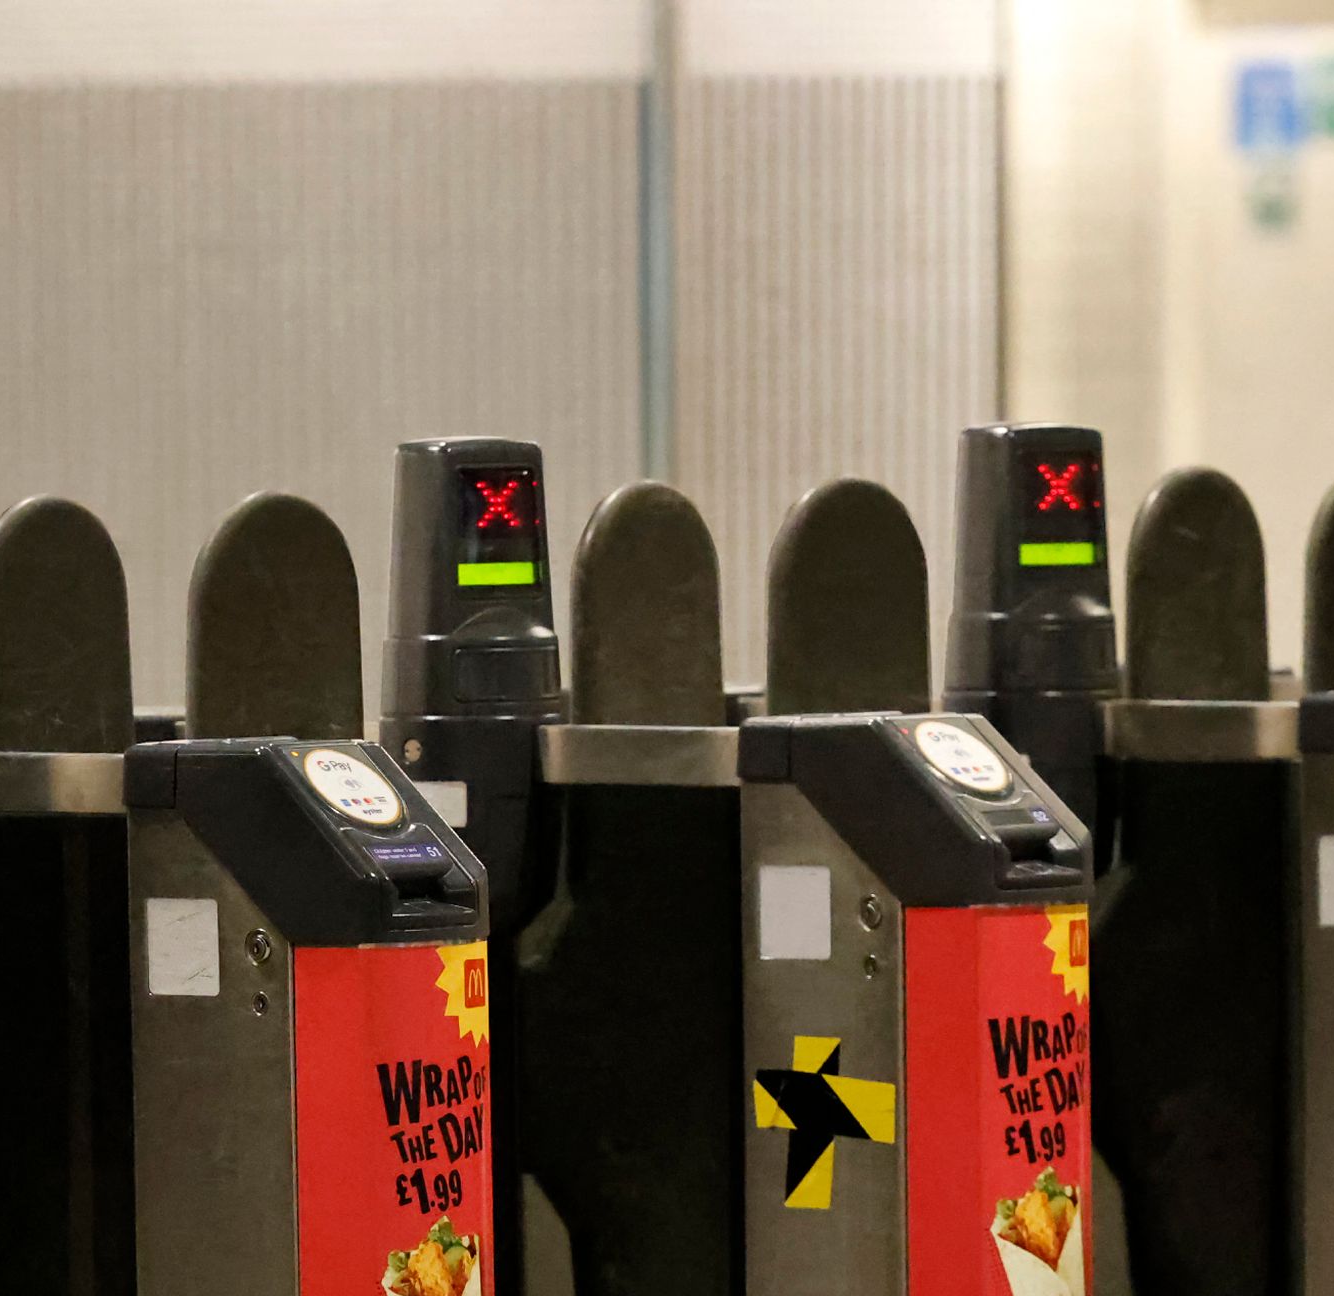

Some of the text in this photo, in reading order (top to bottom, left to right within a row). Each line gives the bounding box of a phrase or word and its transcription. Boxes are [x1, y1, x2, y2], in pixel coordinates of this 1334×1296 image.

[425, 846, 443, 857] 51
[988, 1011, 1076, 1079] WRAP
[376, 1055, 487, 1127] WRAP OF
[999, 1060, 1086, 1116] THE DAY
[389, 1102, 485, 1165] THE DAY
[1005, 1119, 1066, 1164] £1.99
[395, 1167, 463, 1215] £1.99
